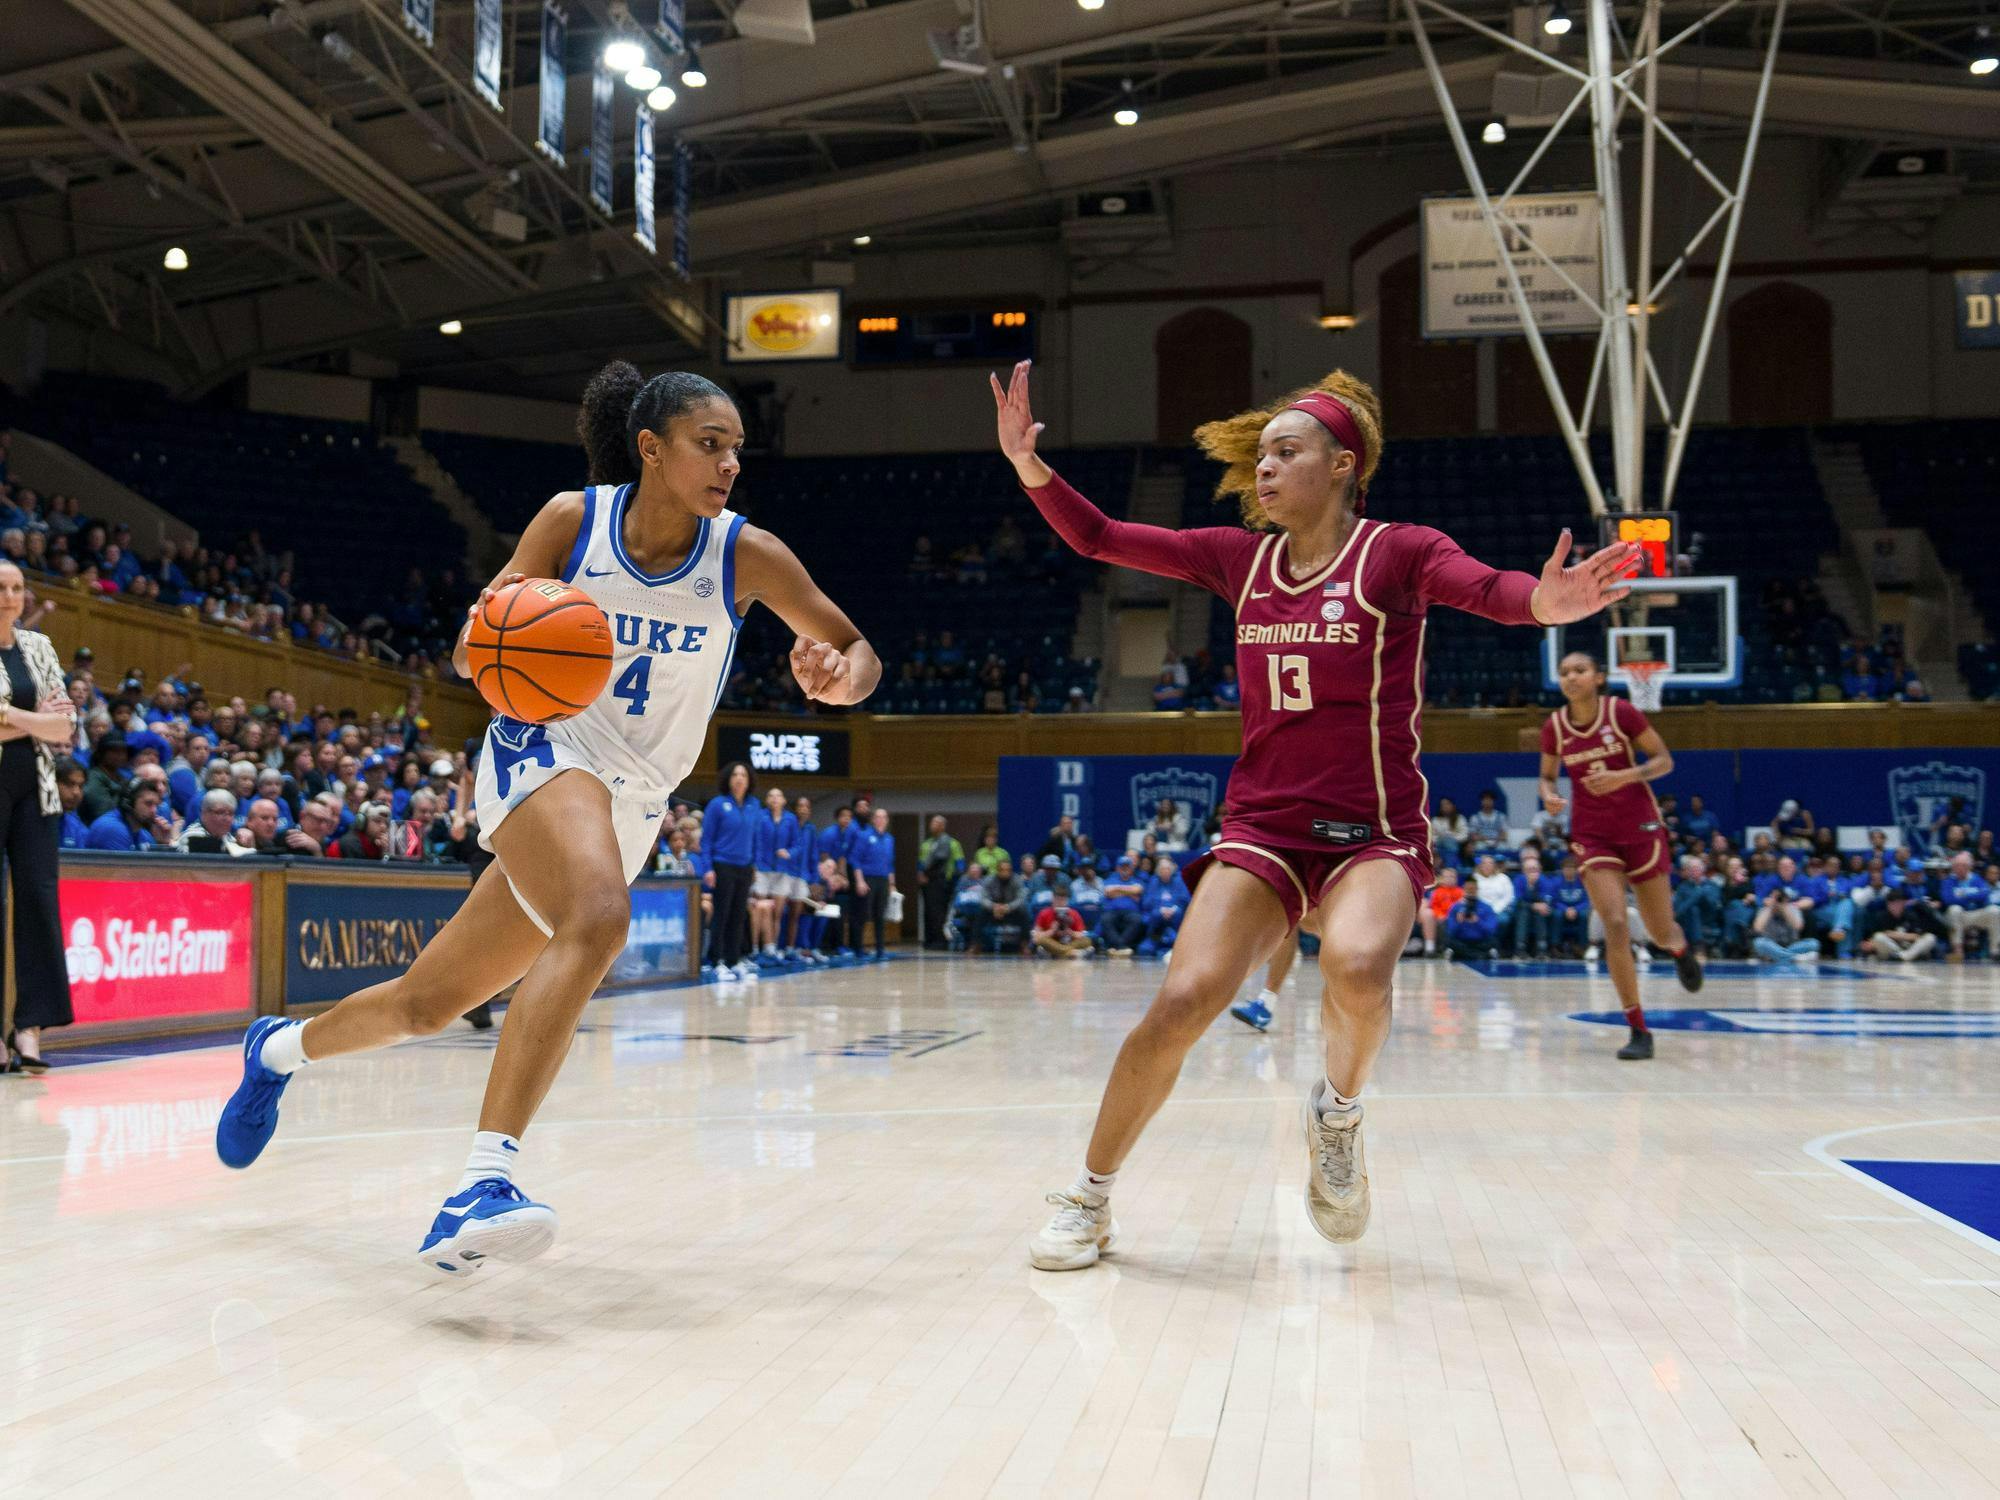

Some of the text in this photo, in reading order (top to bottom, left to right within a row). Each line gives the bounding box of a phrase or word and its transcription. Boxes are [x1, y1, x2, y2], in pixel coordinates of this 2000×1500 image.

[600, 610, 708, 654] UKE
[1237, 622, 1360, 645] SEMINOLES
[613, 655, 654, 716] 4
[1266, 653, 1314, 712] 13
[749, 733, 821, 754] DUDE
[750, 752, 821, 772] WIPES
